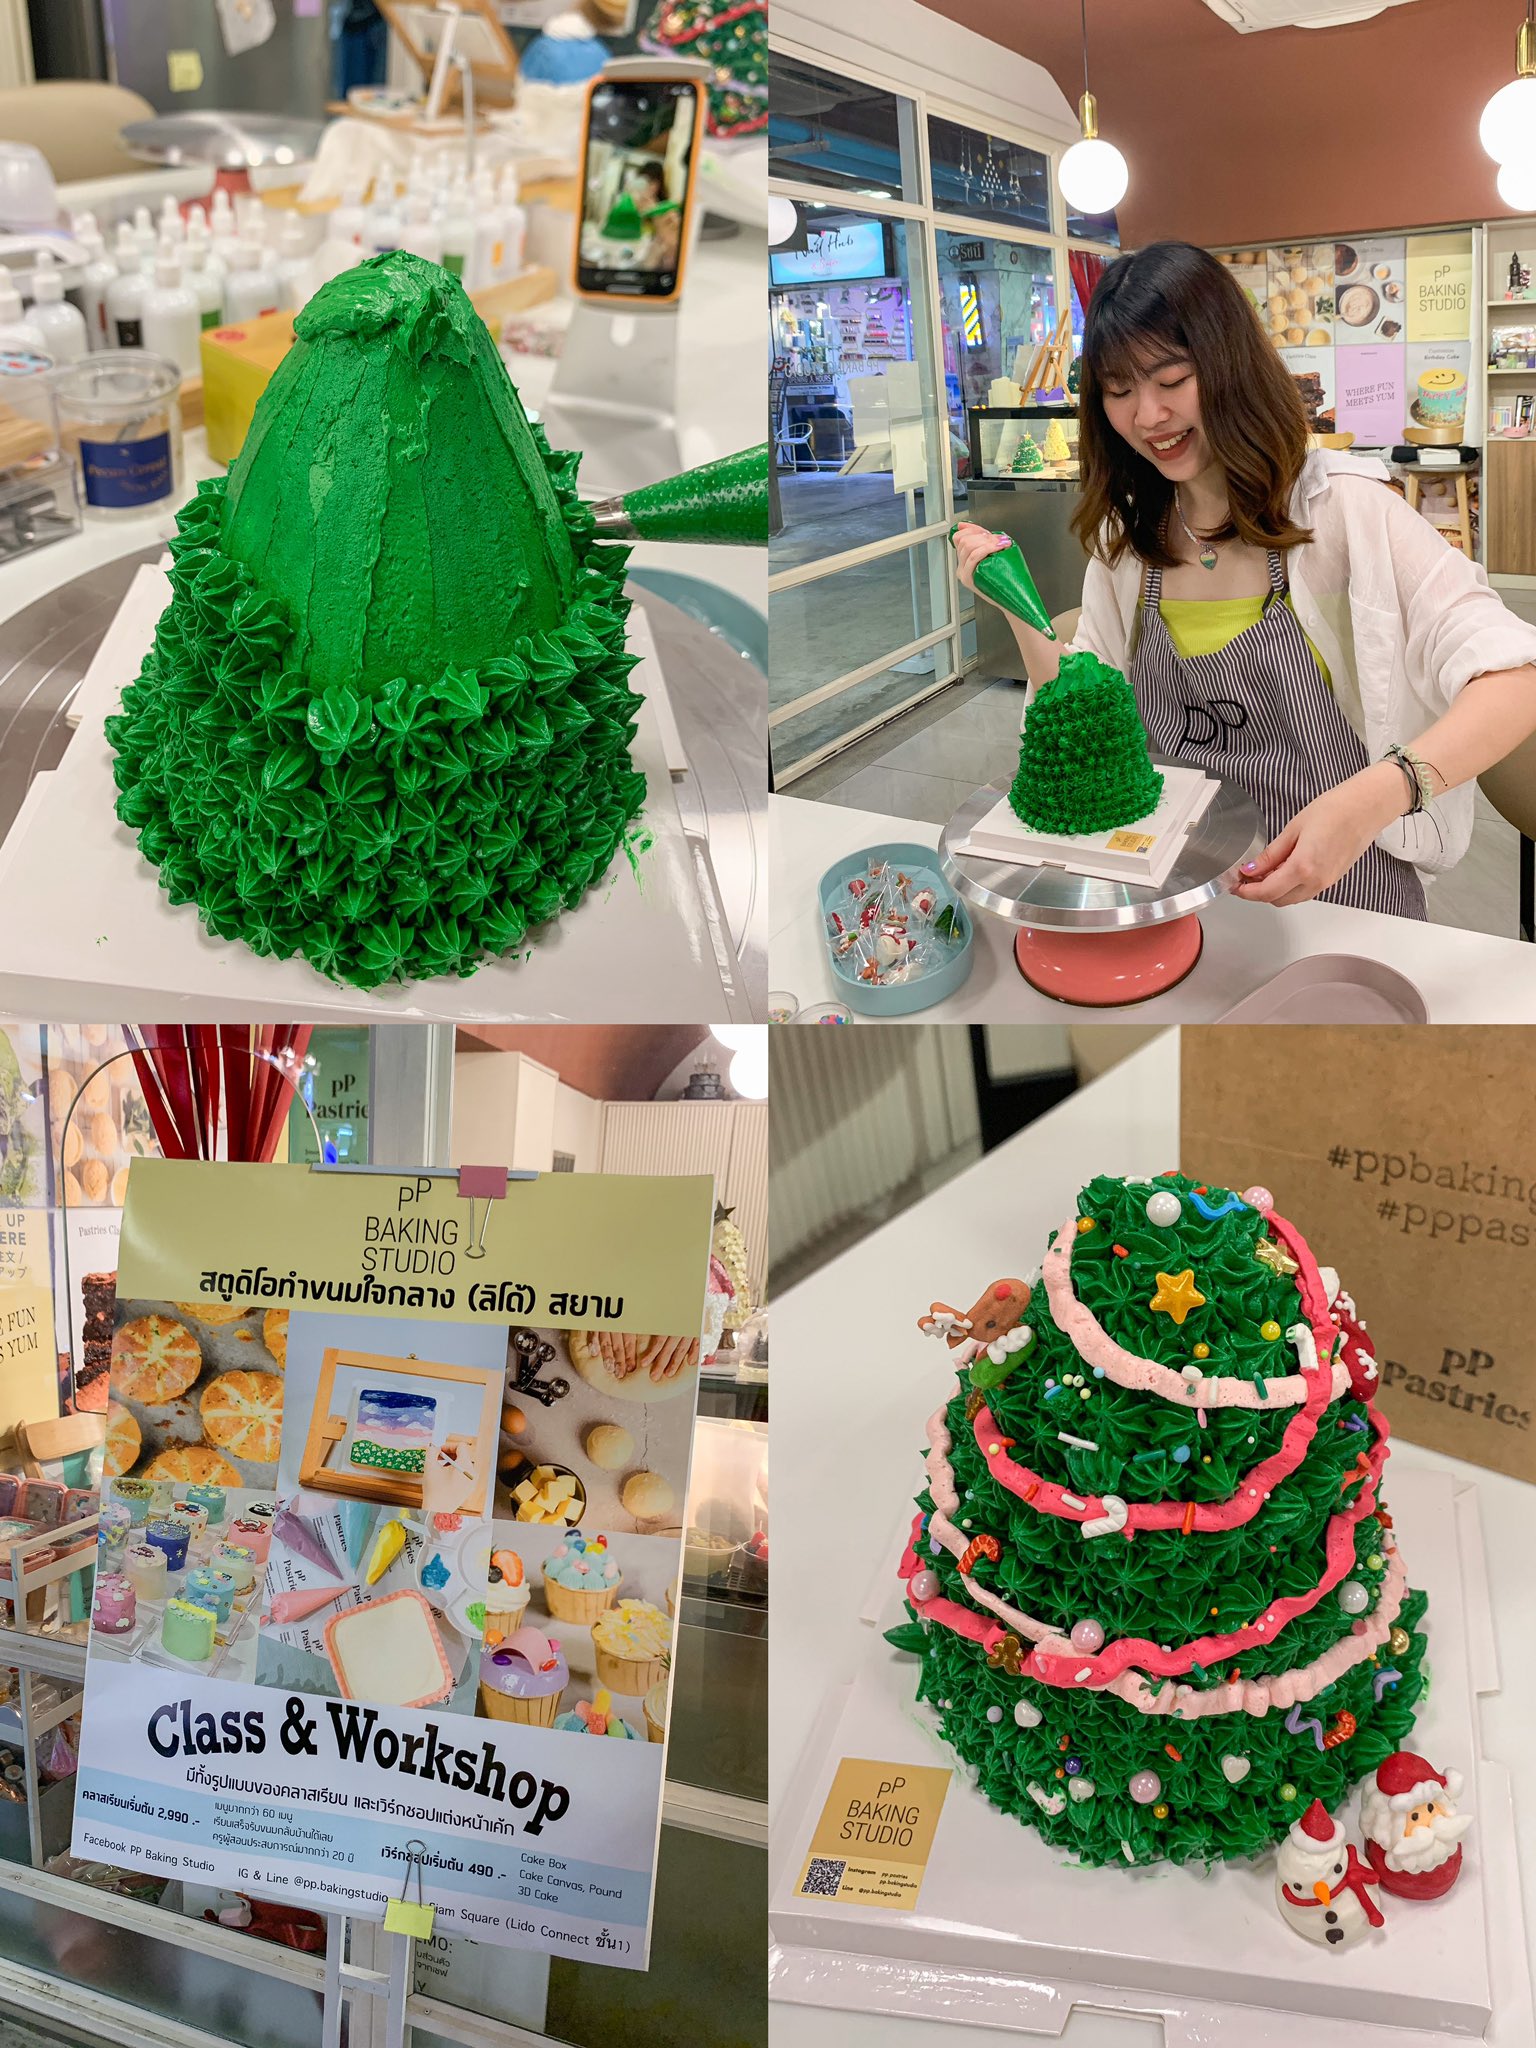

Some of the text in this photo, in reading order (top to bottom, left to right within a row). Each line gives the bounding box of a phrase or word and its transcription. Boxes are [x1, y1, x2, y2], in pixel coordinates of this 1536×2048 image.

[1419, 283, 1466, 298] BAKING
[1419, 297, 1466, 312] STUDIO
[1345, 382, 1395, 398] WHERE FUN
[1345, 392, 1395, 407] MEETS YUM
[6, 1213, 25, 1227] UP
[79, 1225, 107, 1237] Pastries
[364, 1216, 459, 1245] BAKING
[1376, 1199, 1536, 1247] #pppas
[361, 1247, 456, 1275] STUDIO
[200, 1267, 624, 1319] สตูดิโอทำขนมใจกลาง (ลิโด้) สยาม
[7, 1307, 35, 1332] FUN
[7, 1332, 38, 1358] YUM
[333, 1514, 347, 1553] Pastries
[147, 1696, 570, 1836] Class & Workshop
[82, 1789, 154, 1816] คลาสเรียนเริ่มต้น
[158, 1807, 188, 1824] 2,990
[186, 1764, 515, 1836] มีทั้งรูปแบบของคลาสเรียน และเวิร์กชอปแต่งหน้าเค้ก
[214, 1801, 293, 1823] เมนูมากกว่า 60 เมนู
[847, 1799, 920, 1825] BAKING
[840, 1821, 913, 1847] STUDIO
[83, 1832, 215, 1872] Facebook PP Baking Studio
[332, 1850, 345, 1861] 20
[347, 1852, 355, 1863] ปี
[521, 1853, 567, 1870] Cake Box
[468, 1863, 494, 1878] 490
[848, 1867, 876, 1875] Instagram
[238, 1868, 389, 1904] IG & Line @pp.bakingstudio
[518, 1886, 559, 1903] 3D Cake
[519, 1869, 622, 1899] Cake Canvas, Pound
[461, 1909, 500, 1926] Square
[505, 1917, 535, 1932] (Lido
[540, 1925, 590, 1945] Connect
